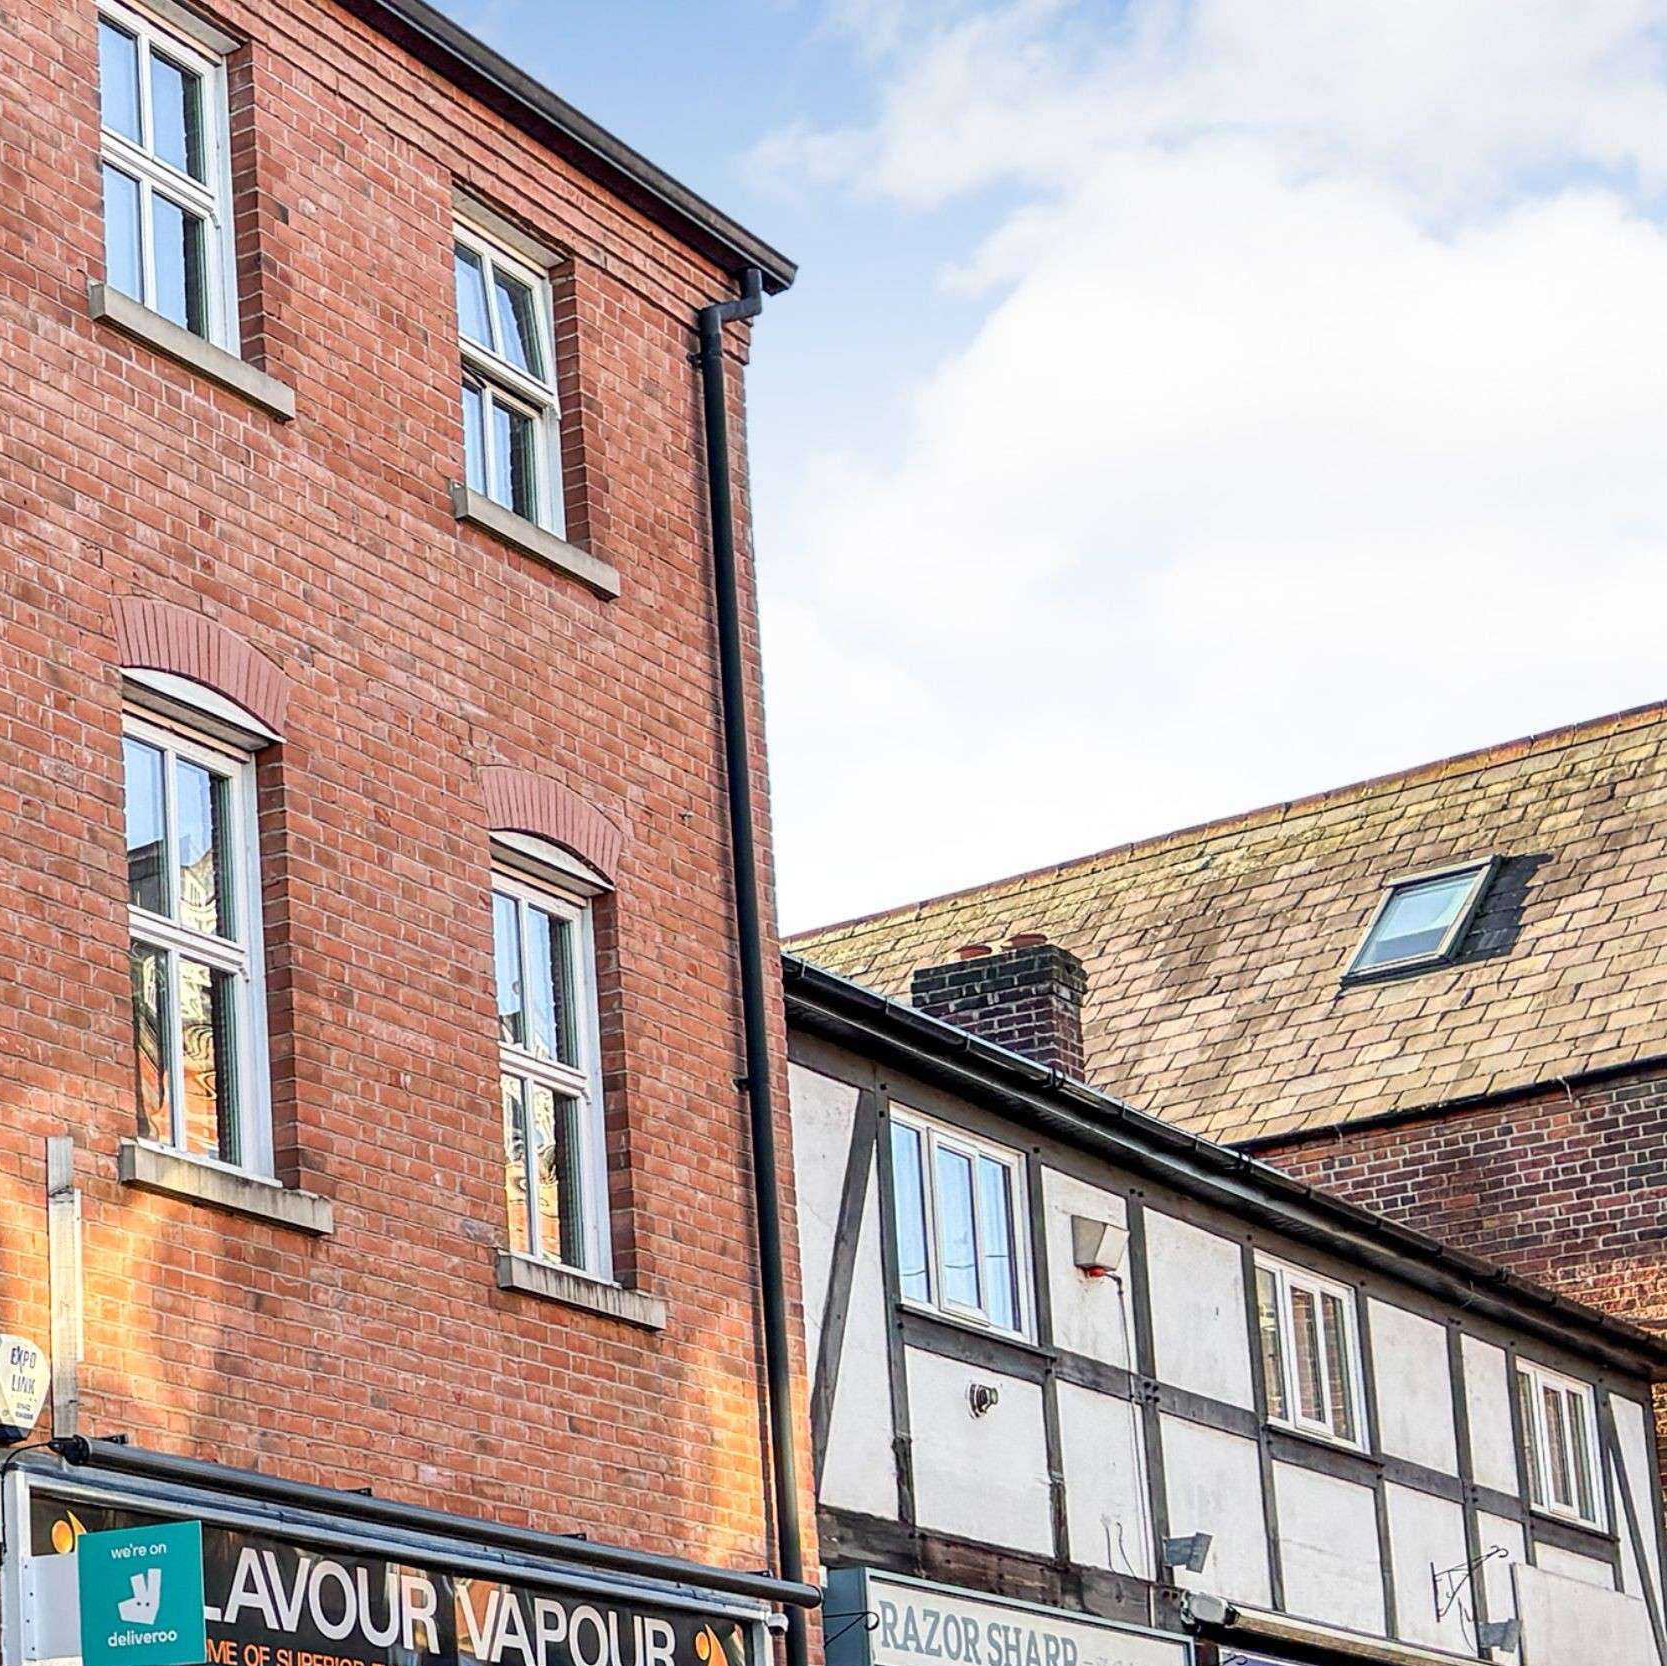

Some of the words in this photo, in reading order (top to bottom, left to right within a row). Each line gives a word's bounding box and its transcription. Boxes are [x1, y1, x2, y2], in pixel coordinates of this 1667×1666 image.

[110, 1544, 149, 1559] we're
[151, 1543, 167, 1554] on
[204, 1547, 440, 1655] AVOUR
[108, 1629, 178, 1648] deliveroo
[879, 1600, 982, 1666] RAZOR
[206, 1637, 238, 1666] ME
